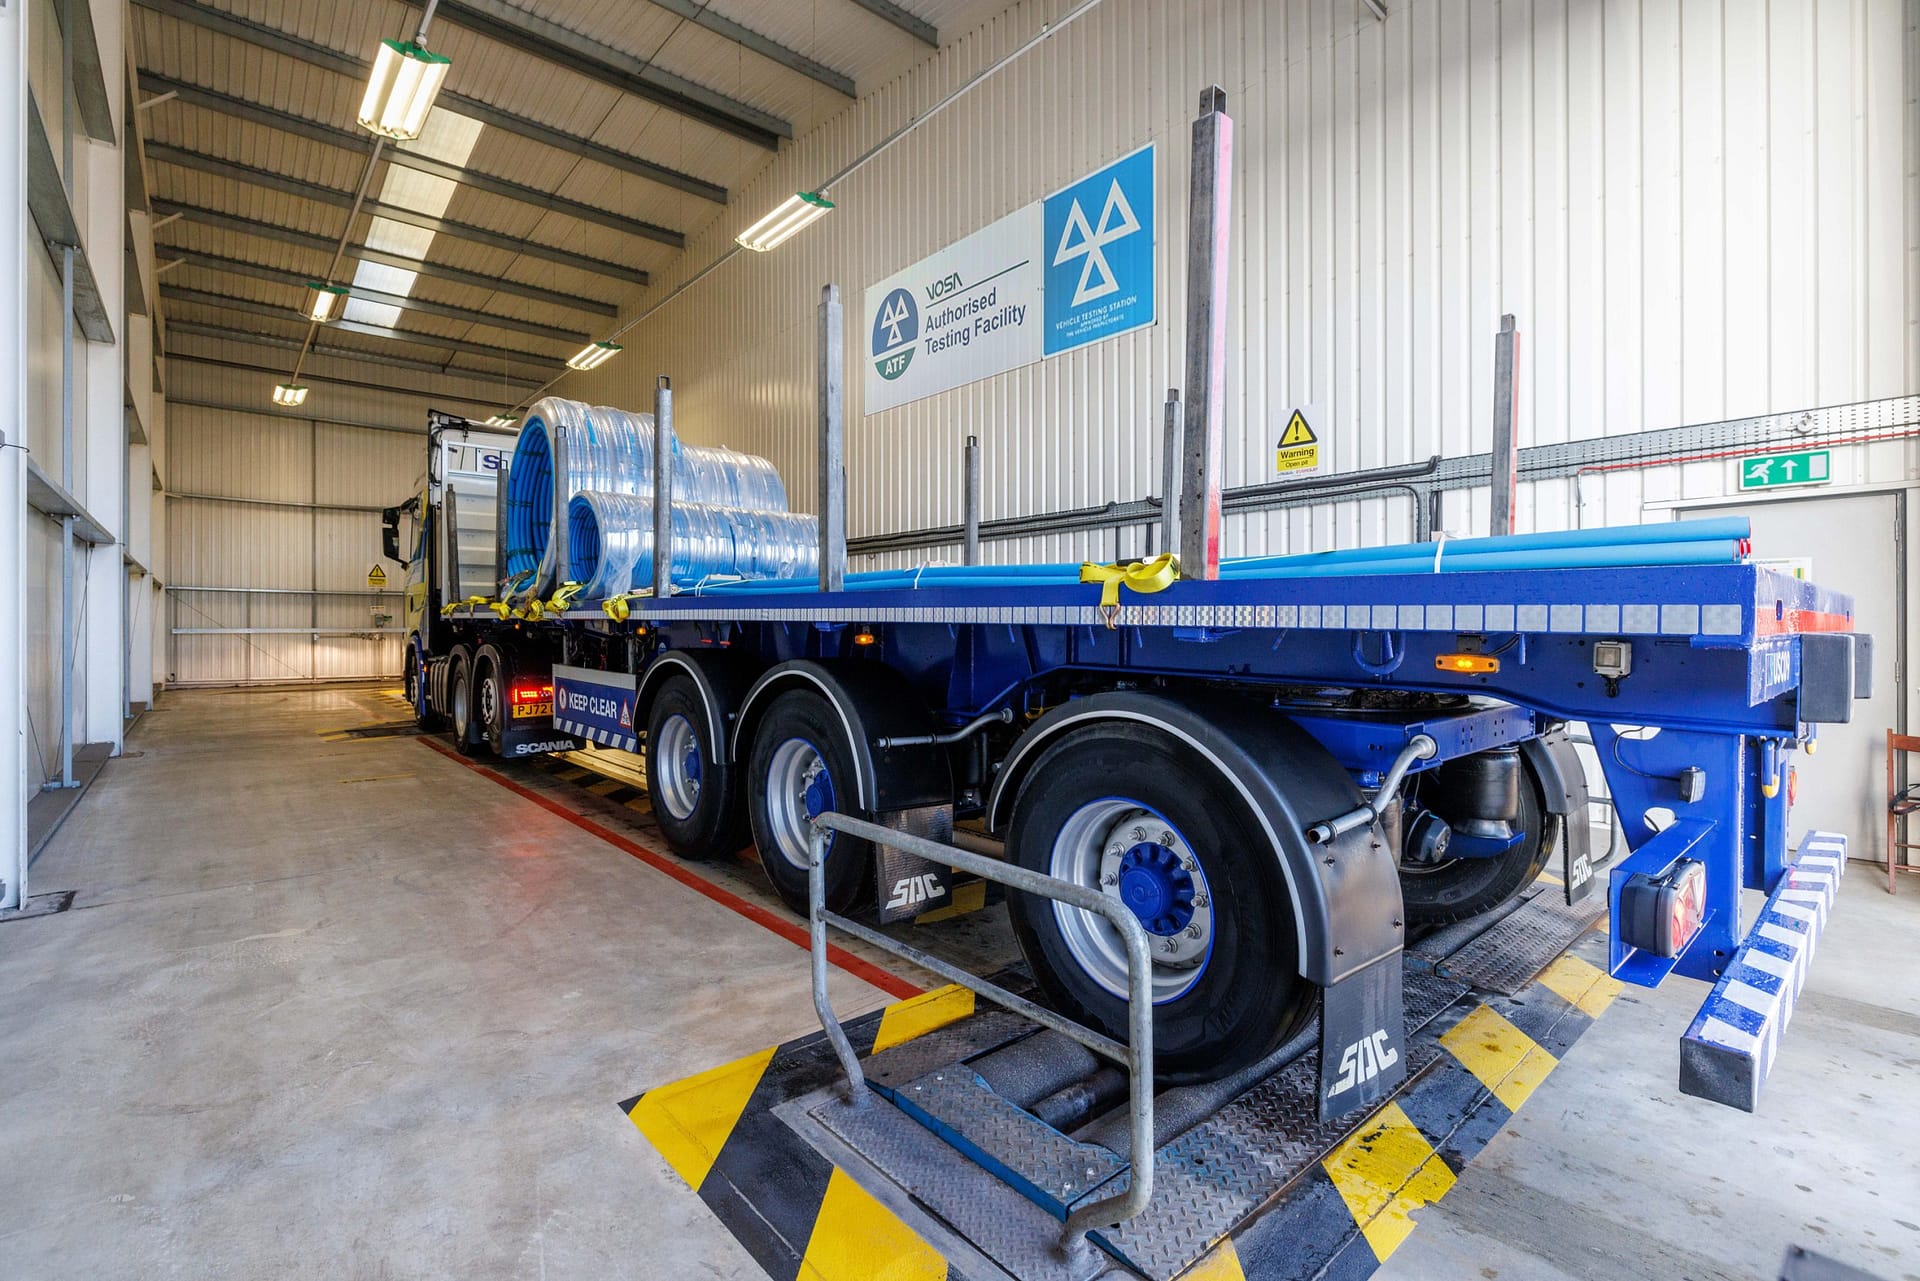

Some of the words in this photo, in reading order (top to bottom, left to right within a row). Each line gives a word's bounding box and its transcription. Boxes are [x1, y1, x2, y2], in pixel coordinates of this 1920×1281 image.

[925, 272, 963, 300] VOSA
[925, 286, 997, 333] Authorised
[1056, 315, 1080, 330] VEHICLE
[1081, 305, 1108, 320] TESTING
[1109, 295, 1137, 311] STATION
[924, 326, 970, 355] Testing
[974, 304, 1027, 337] Facility
[885, 354, 906, 375] ATF
[1281, 448, 1314, 459] Warning
[518, 704, 547, 716] PJ72
[569, 692, 588, 712] KEEP
[589, 696, 617, 719] CLEAR
[516, 740, 575, 753] SCANIA
[1571, 853, 1593, 890] SDC
[885, 873, 946, 910] SDC
[1327, 1029, 1399, 1098] SDC
